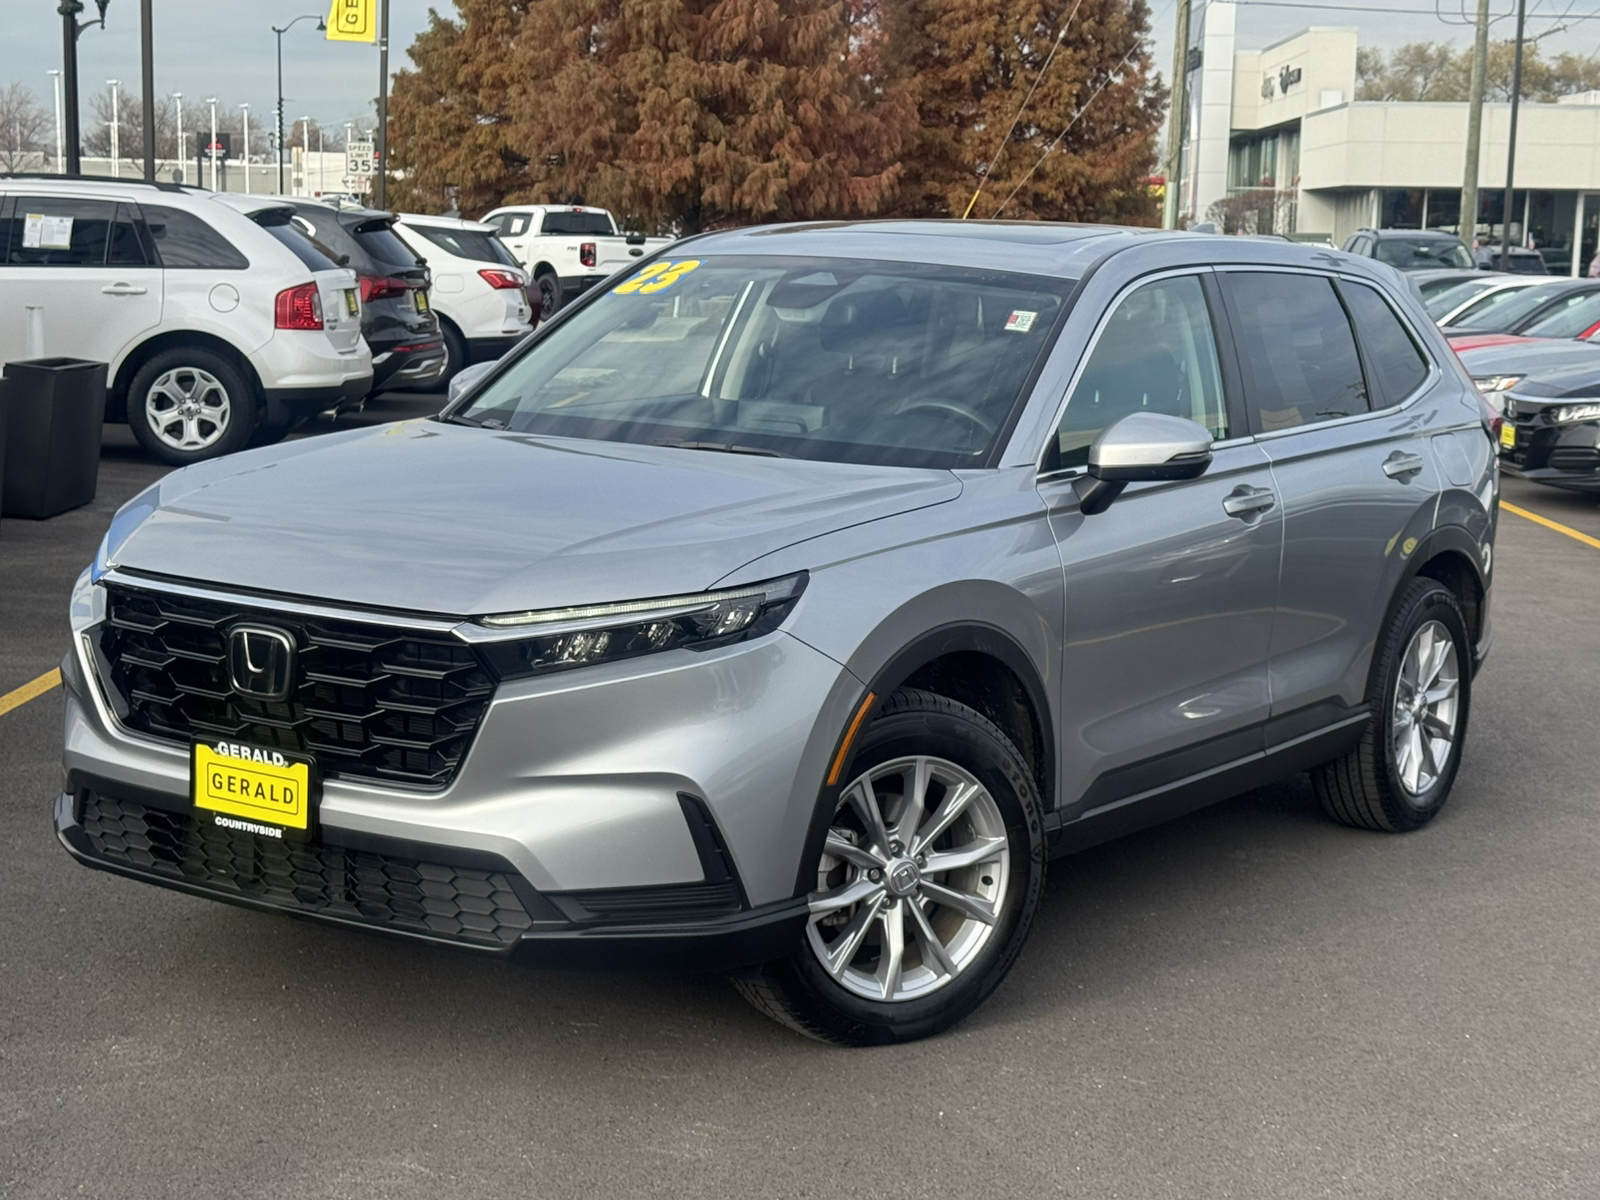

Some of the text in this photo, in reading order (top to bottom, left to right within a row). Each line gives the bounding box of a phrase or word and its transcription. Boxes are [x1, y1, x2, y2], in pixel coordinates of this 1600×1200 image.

[349, 159, 371, 172] 35
[613, 260, 700, 294] 23
[217, 741, 285, 767] GERALD
[211, 772, 294, 805] GERALD
[214, 816, 282, 839] COUNTRYSIDE
